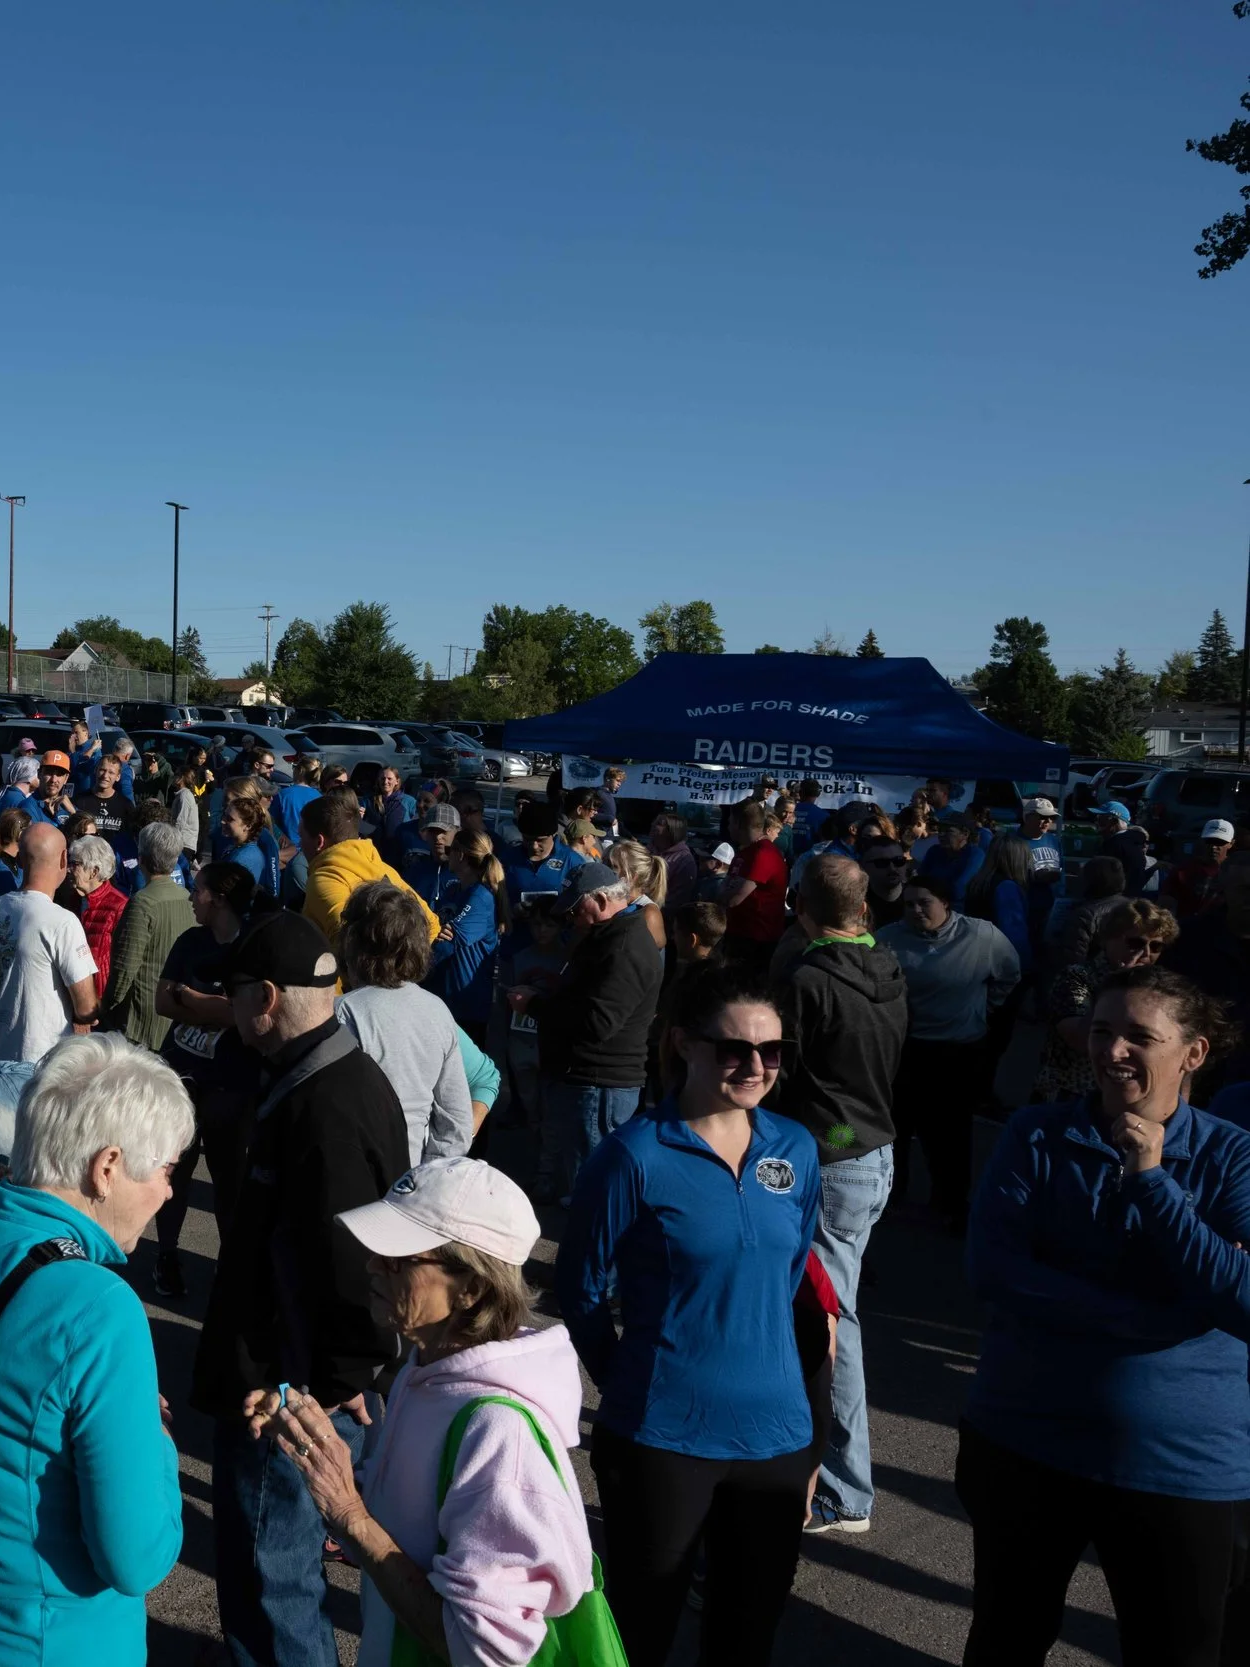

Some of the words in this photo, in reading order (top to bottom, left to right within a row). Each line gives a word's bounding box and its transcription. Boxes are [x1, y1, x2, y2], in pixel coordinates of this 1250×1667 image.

[686, 702, 745, 718] MADE
[750, 700, 793, 712] FOR
[798, 703, 870, 725] SHADE
[693, 738, 834, 768] RAIDERS
[650, 764, 674, 774] Tom
[678, 767, 718, 780] Pfeifle
[783, 770, 799, 779] 5k
[689, 792, 715, 801] H-M
[181, 1026, 208, 1051] 930
